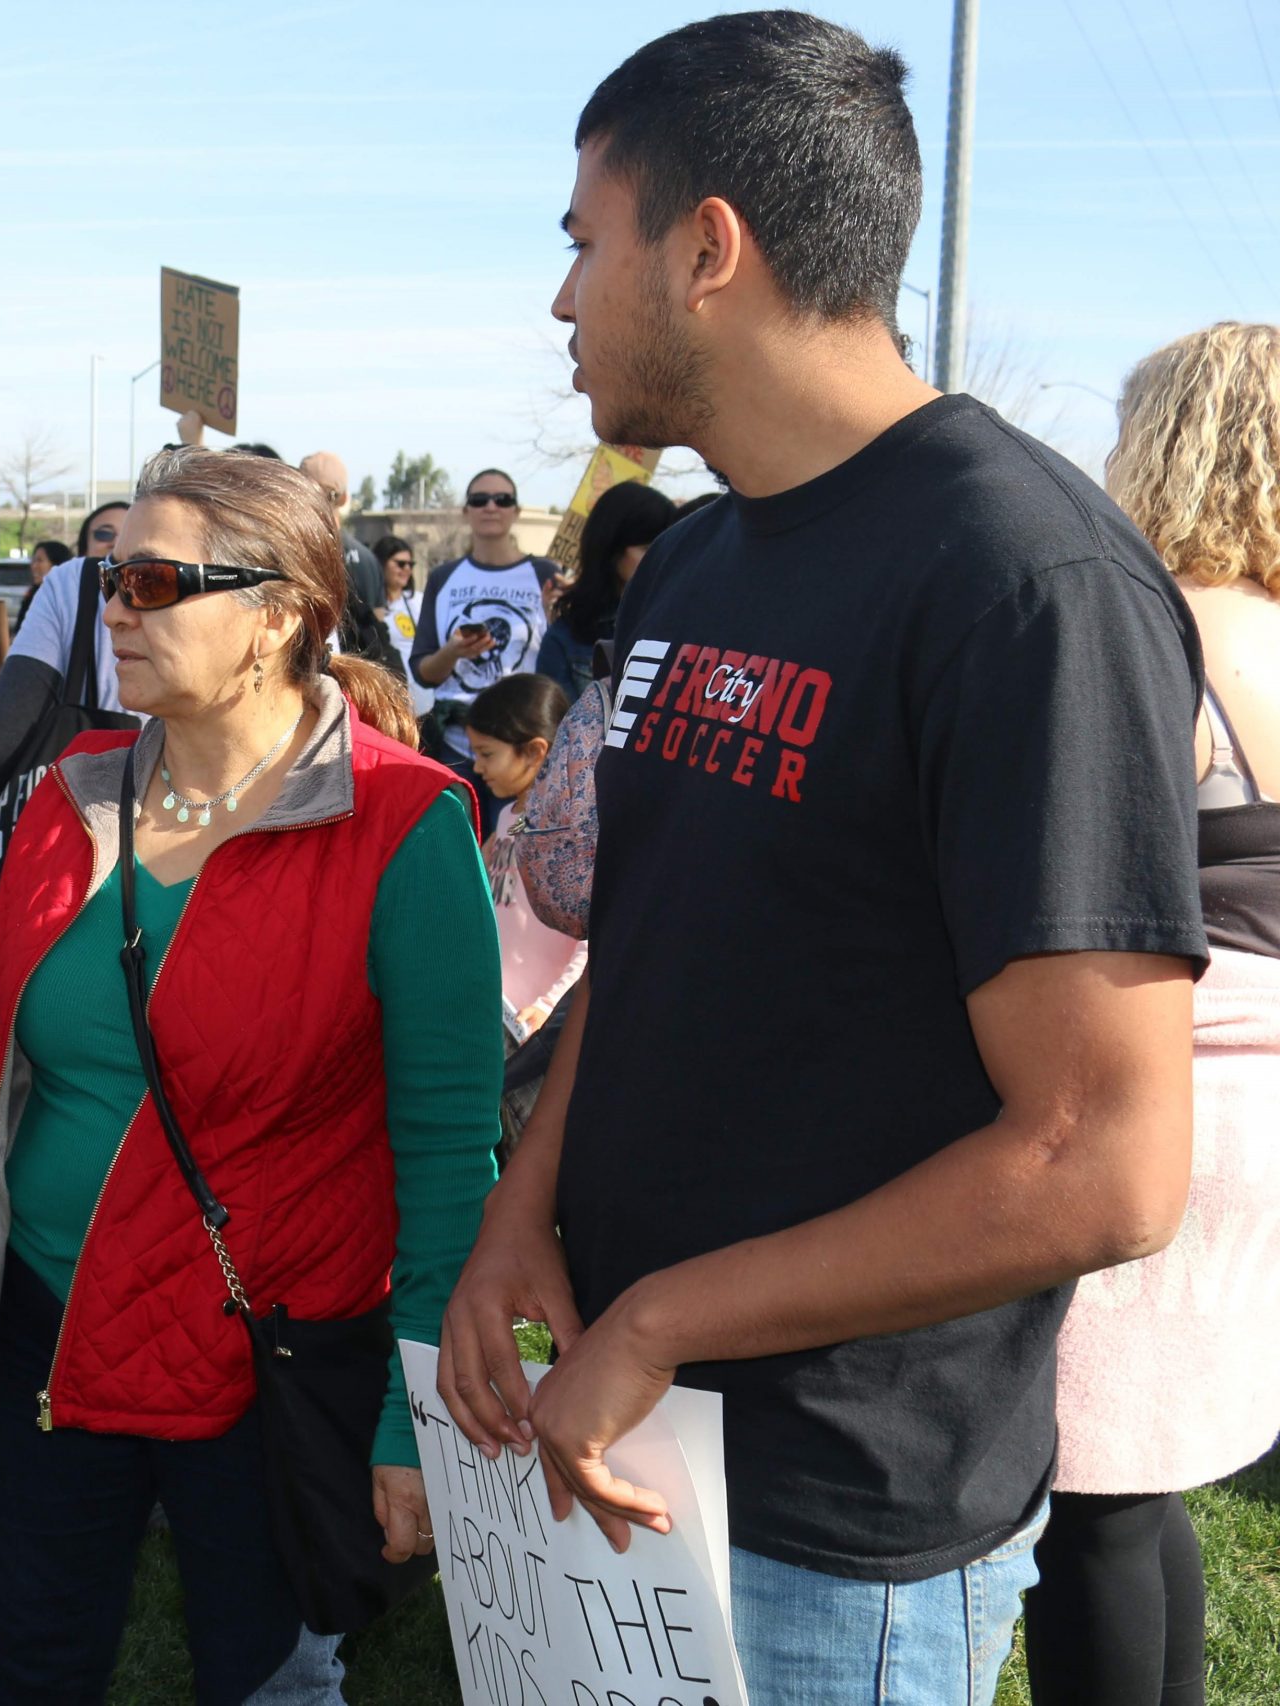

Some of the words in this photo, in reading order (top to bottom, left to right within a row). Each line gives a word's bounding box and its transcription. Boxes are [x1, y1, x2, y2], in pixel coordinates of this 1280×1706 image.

[176, 278, 217, 317] HATE
[171, 308, 192, 336] IS
[197, 317, 225, 350] NOT
[163, 333, 237, 385] WELCOME
[176, 368, 217, 408] HERE
[450, 585, 476, 598] RISE
[652, 643, 832, 747] FRESNO
[704, 664, 765, 723] City
[634, 711, 806, 802] SOCCER
[448, 1510, 551, 1649] ABOUT
[564, 1573, 711, 1684] THE
